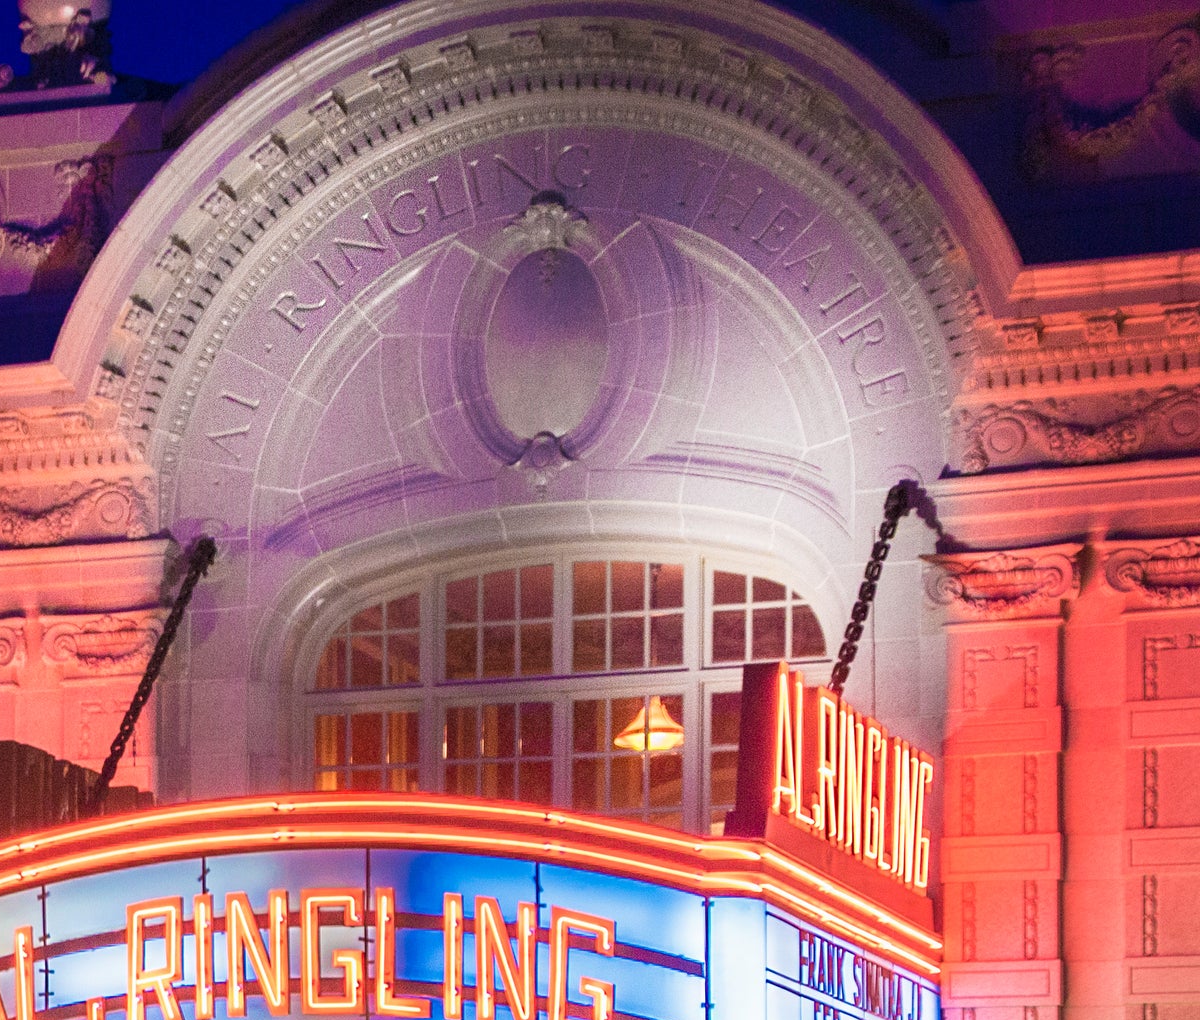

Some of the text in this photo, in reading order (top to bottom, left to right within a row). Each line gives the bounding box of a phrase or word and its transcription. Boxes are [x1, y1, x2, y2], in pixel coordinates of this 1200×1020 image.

[269, 145, 594, 333] RINGLING
[816, 686, 935, 898] RINGLING
[799, 928, 845, 1002] FRANK
